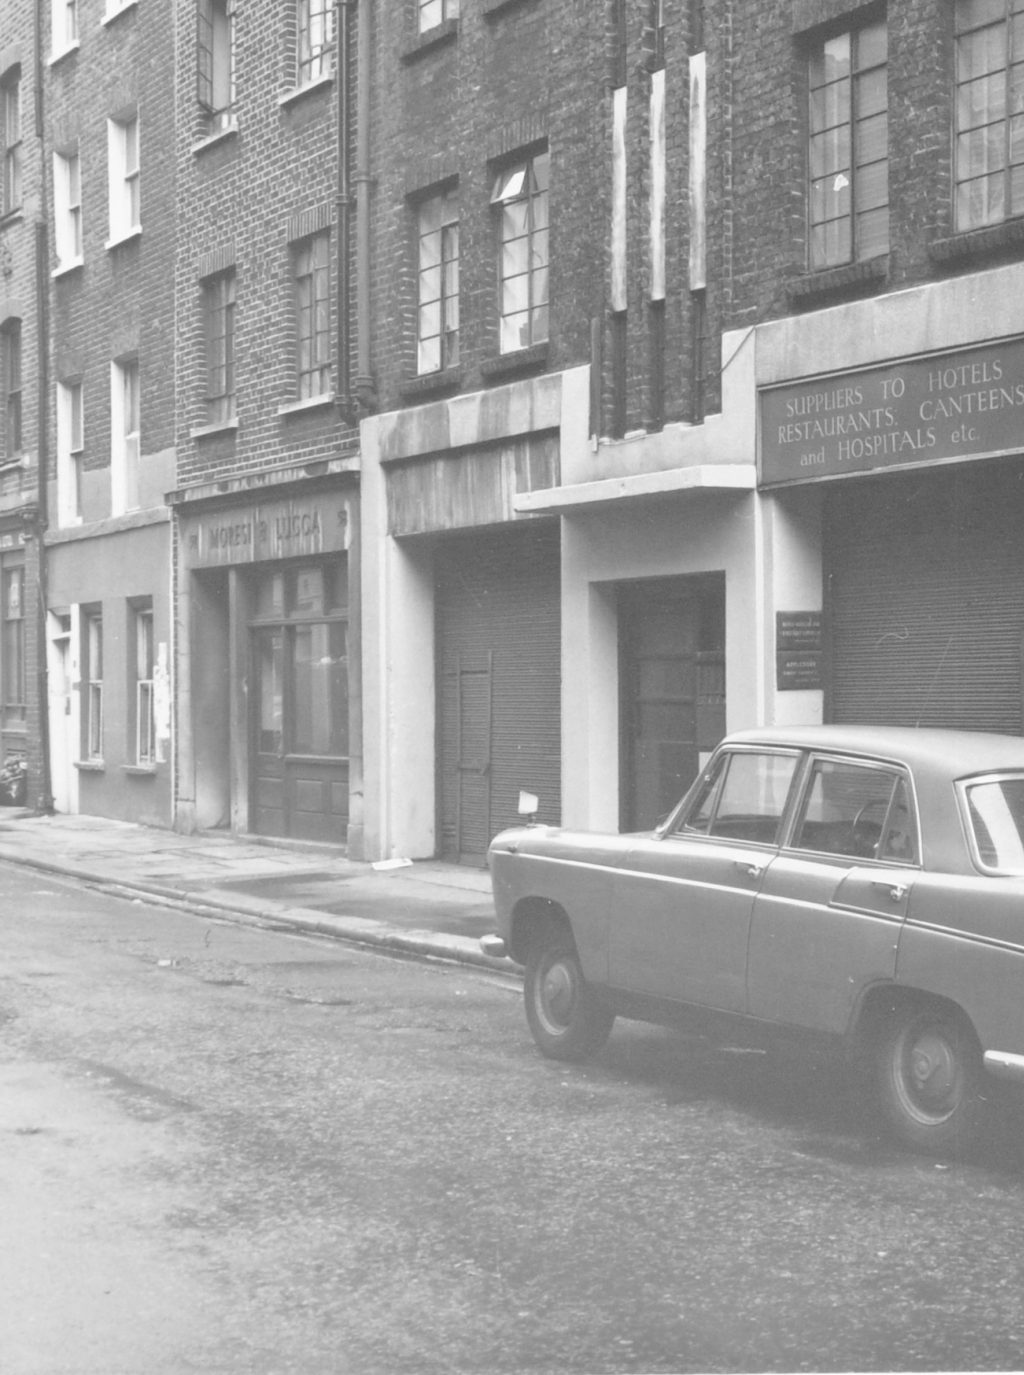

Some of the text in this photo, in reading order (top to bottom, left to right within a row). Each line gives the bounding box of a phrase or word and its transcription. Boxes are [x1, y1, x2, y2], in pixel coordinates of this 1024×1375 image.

[786, 360, 1003, 417] SUPPLIERS TO HOTELS
[800, 447, 826, 466] and
[837, 427, 937, 461] HOSPITALS
